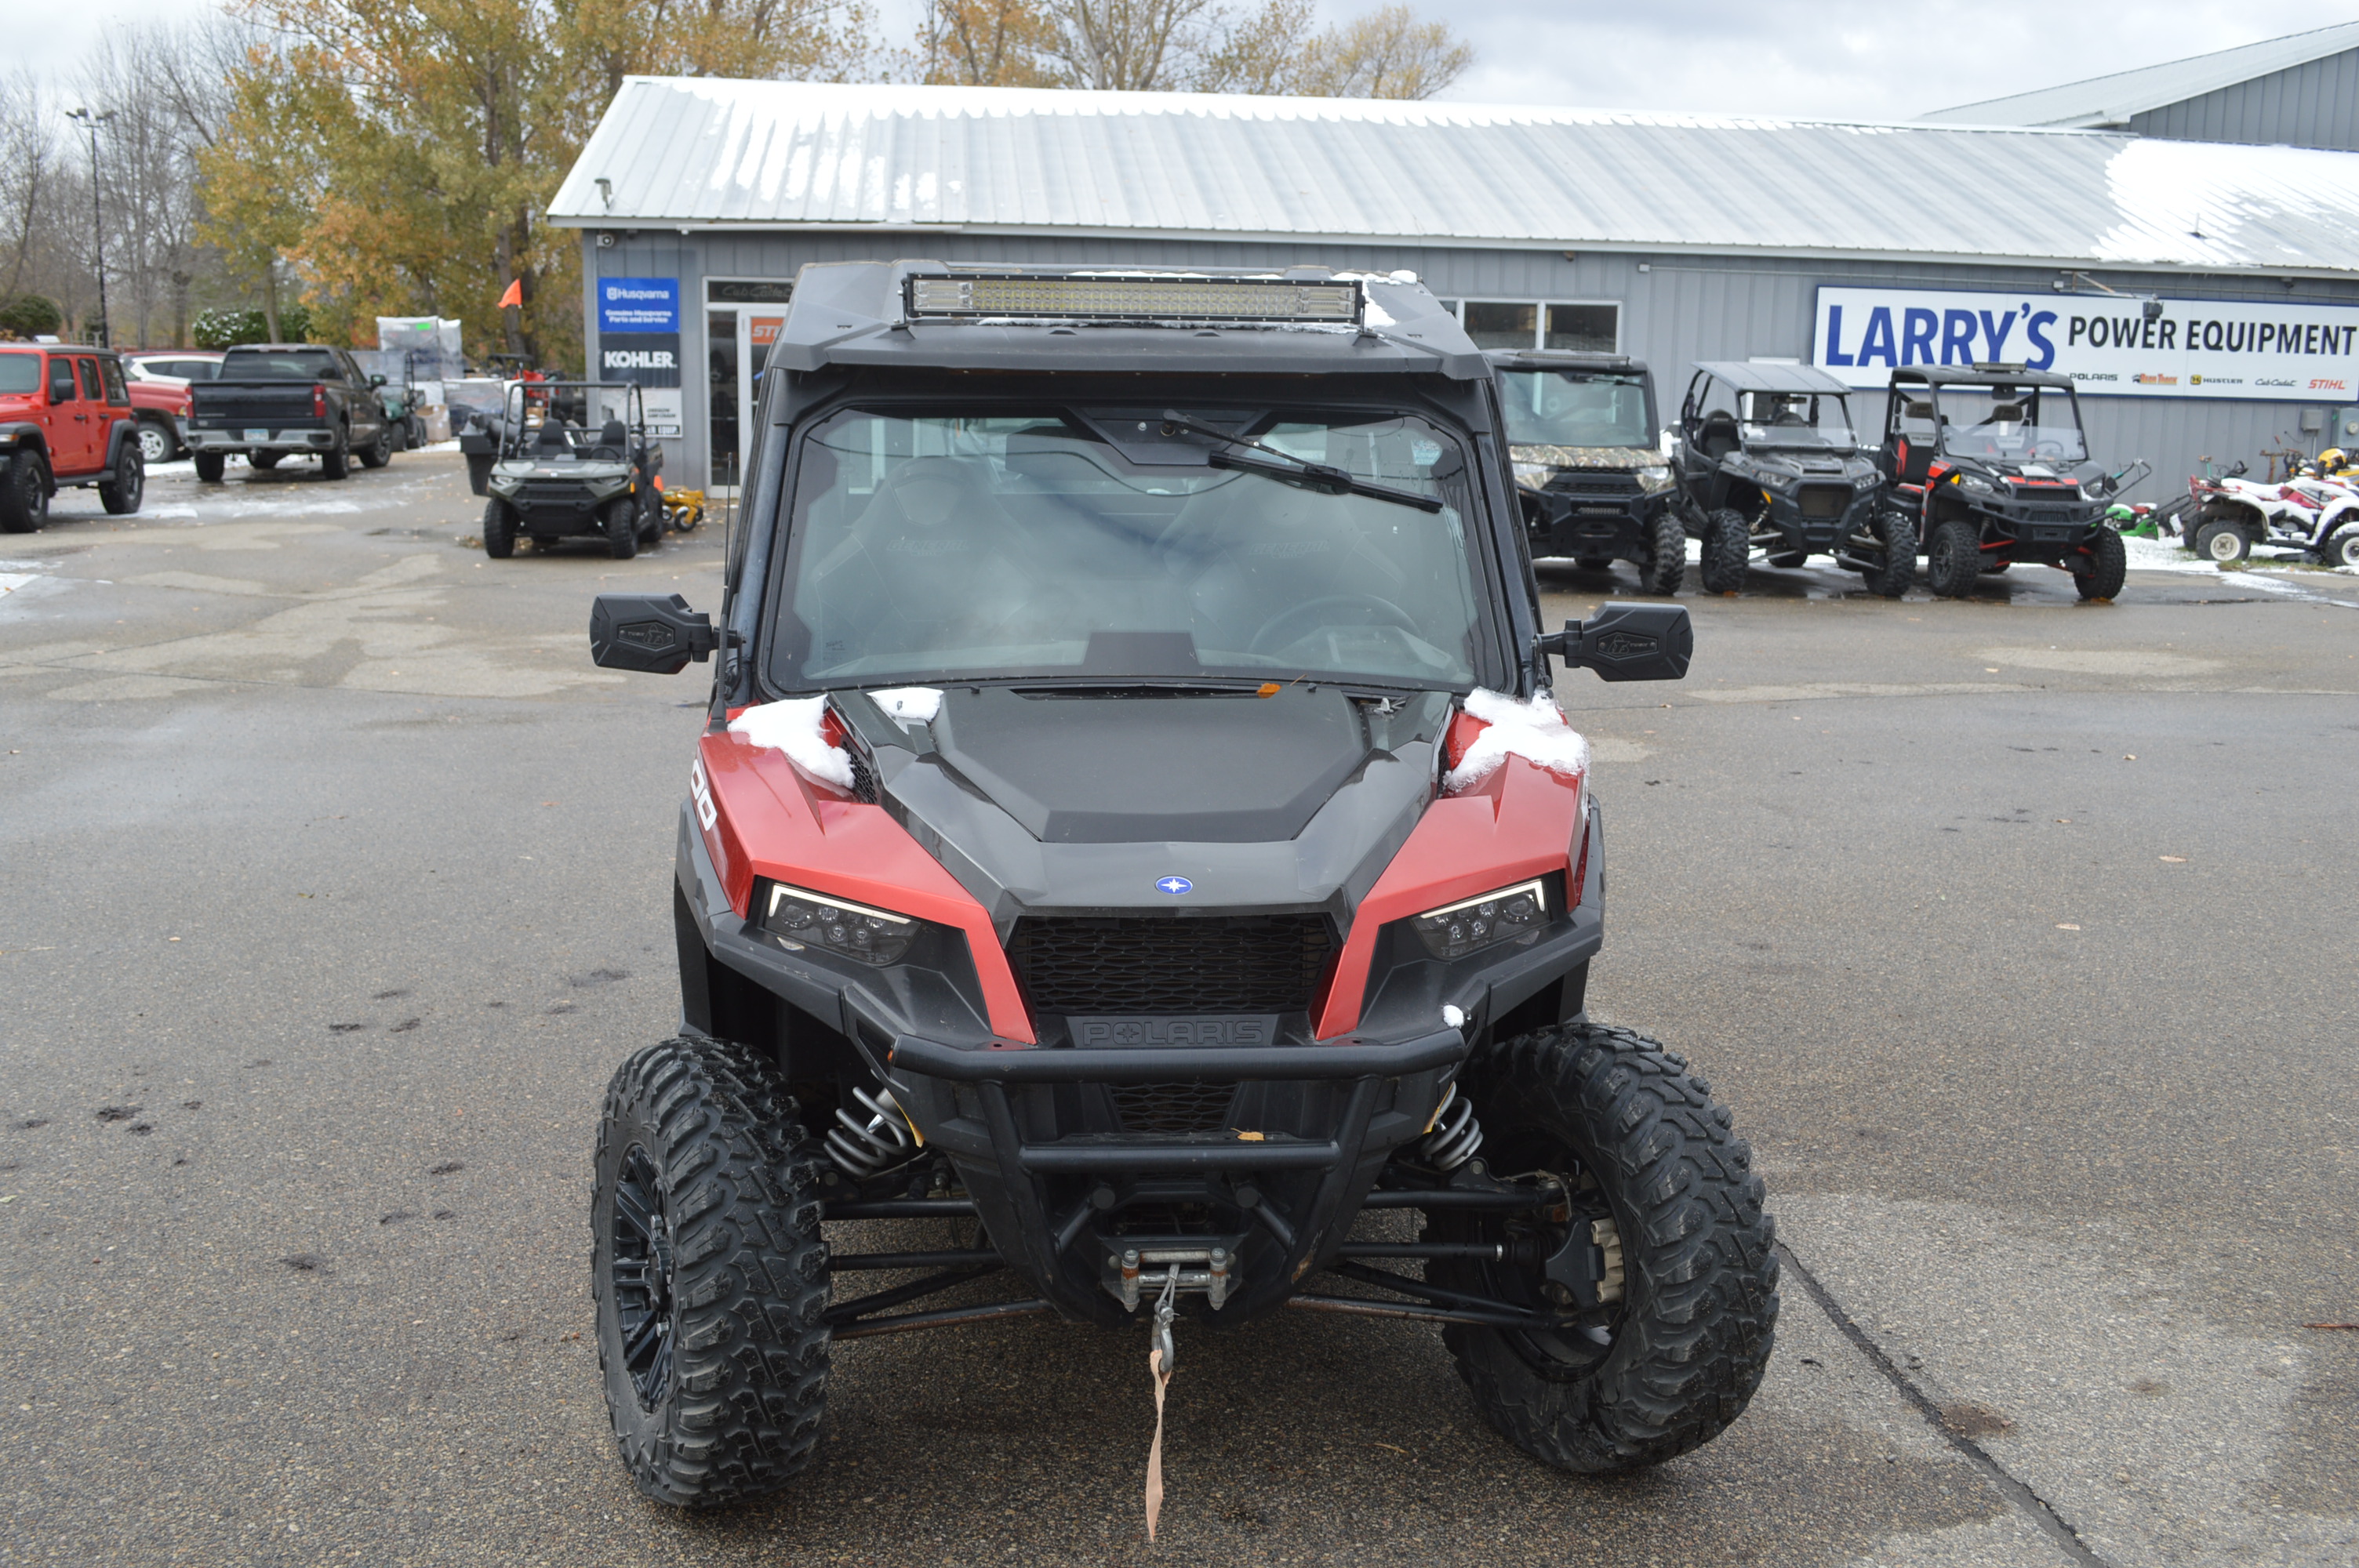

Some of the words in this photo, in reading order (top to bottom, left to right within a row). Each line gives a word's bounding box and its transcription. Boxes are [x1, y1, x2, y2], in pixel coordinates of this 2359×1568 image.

[617, 288, 670, 300] Husqvarna
[752, 325, 782, 337] STI
[1826, 302, 2059, 371] LARRY'S
[2068, 316, 2177, 350] POWER
[2186, 320, 2357, 356] EQUIPMENT
[605, 351, 674, 368] KOHLER
[2069, 372, 2118, 381] POLARIS
[2308, 379, 2346, 390] STIHL
[1083, 1022, 1262, 1045] POLARIS
